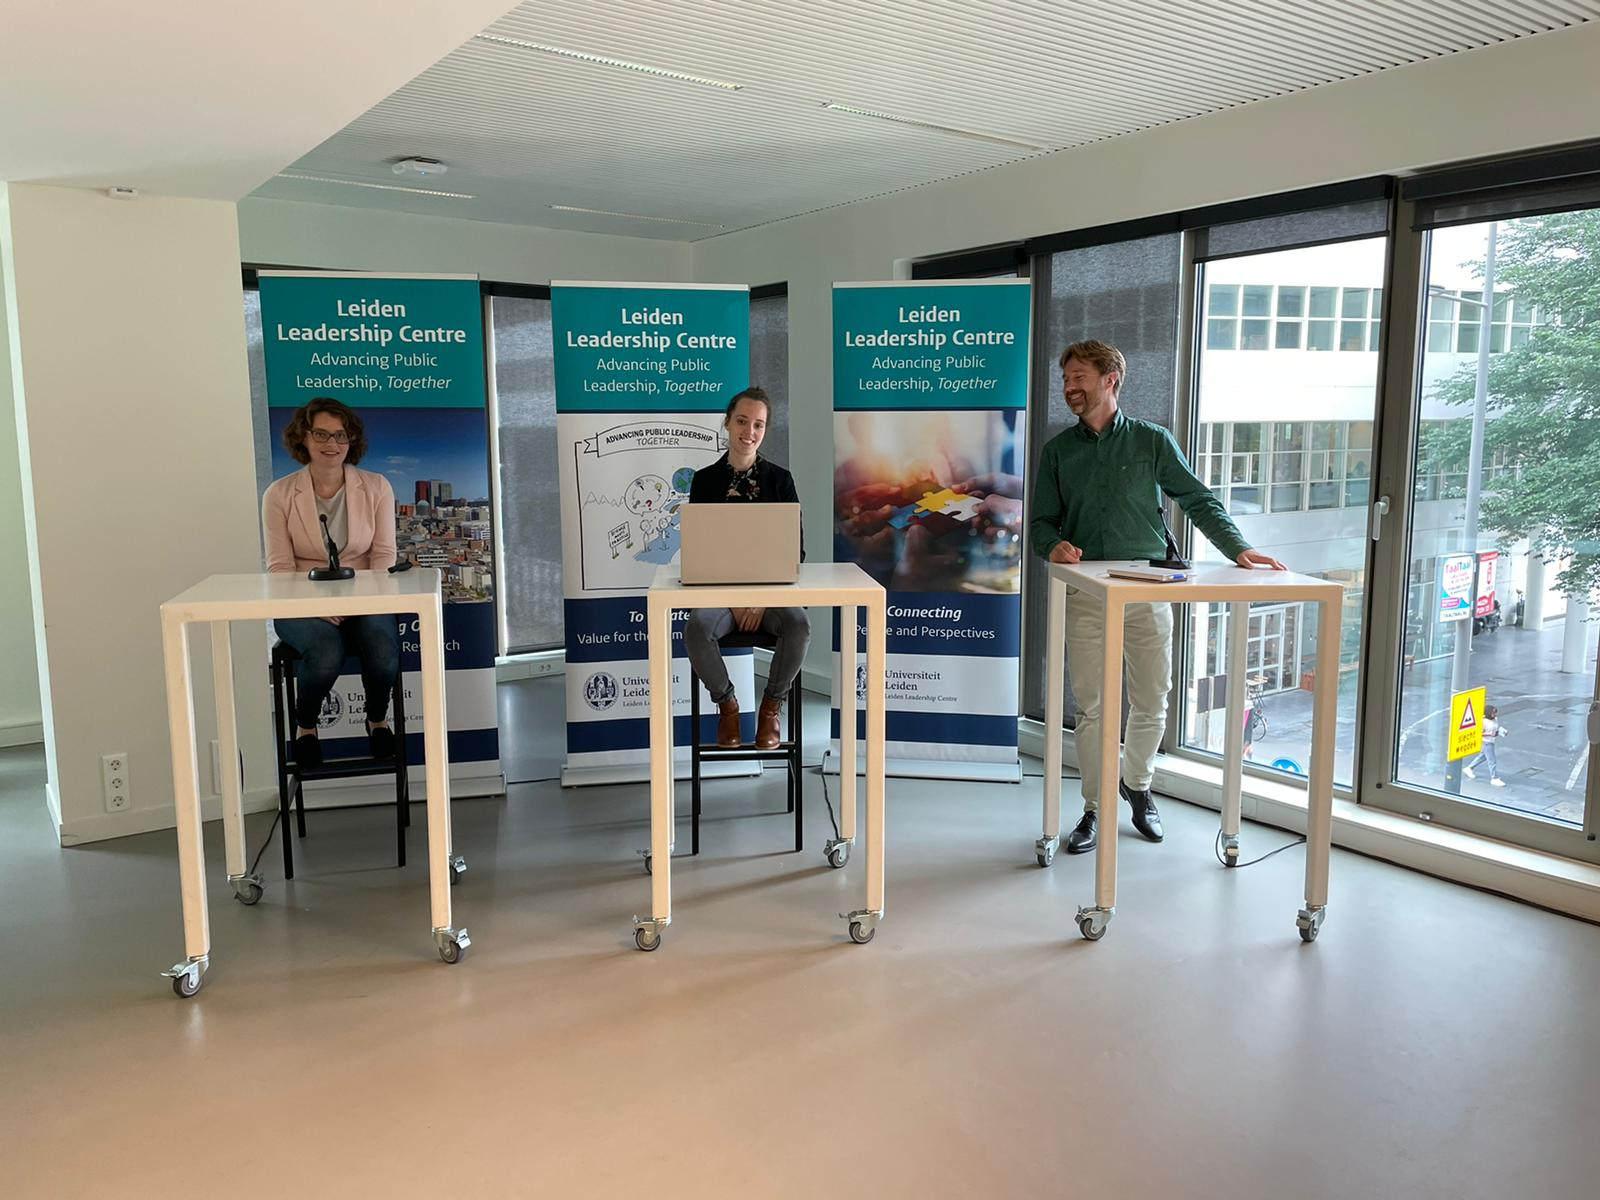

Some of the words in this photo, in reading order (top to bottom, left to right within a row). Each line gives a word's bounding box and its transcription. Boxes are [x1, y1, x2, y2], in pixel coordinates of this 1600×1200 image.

[337, 299, 406, 318] Leiden
[621, 308, 683, 325] Leiden
[899, 306, 961, 323] Leiden
[277, 323, 393, 347] Leadership
[399, 325, 466, 344] Centre
[567, 331, 671, 353] Leadership
[676, 332, 737, 349] Centre
[845, 329, 947, 350] Leadership
[952, 329, 1015, 345] Centre
[310, 352, 390, 370] Advancing
[394, 353, 438, 367] Public
[596, 358, 667, 374] Advancing
[671, 359, 711, 371] Public
[872, 356, 941, 372] Advancing
[945, 355, 986, 368] Public
[296, 375, 383, 392] Leadership,
[387, 375, 452, 392] Together
[583, 379, 660, 395] Leadership,
[664, 379, 723, 395] Together
[859, 377, 934, 393] Leadership,
[938, 377, 998, 393] Together
[606, 429, 644, 444] ADVANCING
[644, 428, 671, 436] PUBLIC
[671, 428, 713, 442] LEADERSHIP
[637, 437, 680, 446] TOGETHER
[629, 611, 644, 623] To
[887, 605, 962, 621] Connecting
[577, 632, 610, 645] Value
[614, 631, 631, 643] for
[896, 625, 918, 636] and
[921, 626, 995, 640] Perspectives
[885, 670, 941, 681] Universiteit
[623, 687, 650, 698] Leide
[885, 681, 918, 691] Leiden
[623, 700, 644, 708] Leiden
[905, 694, 937, 702] Leadership
